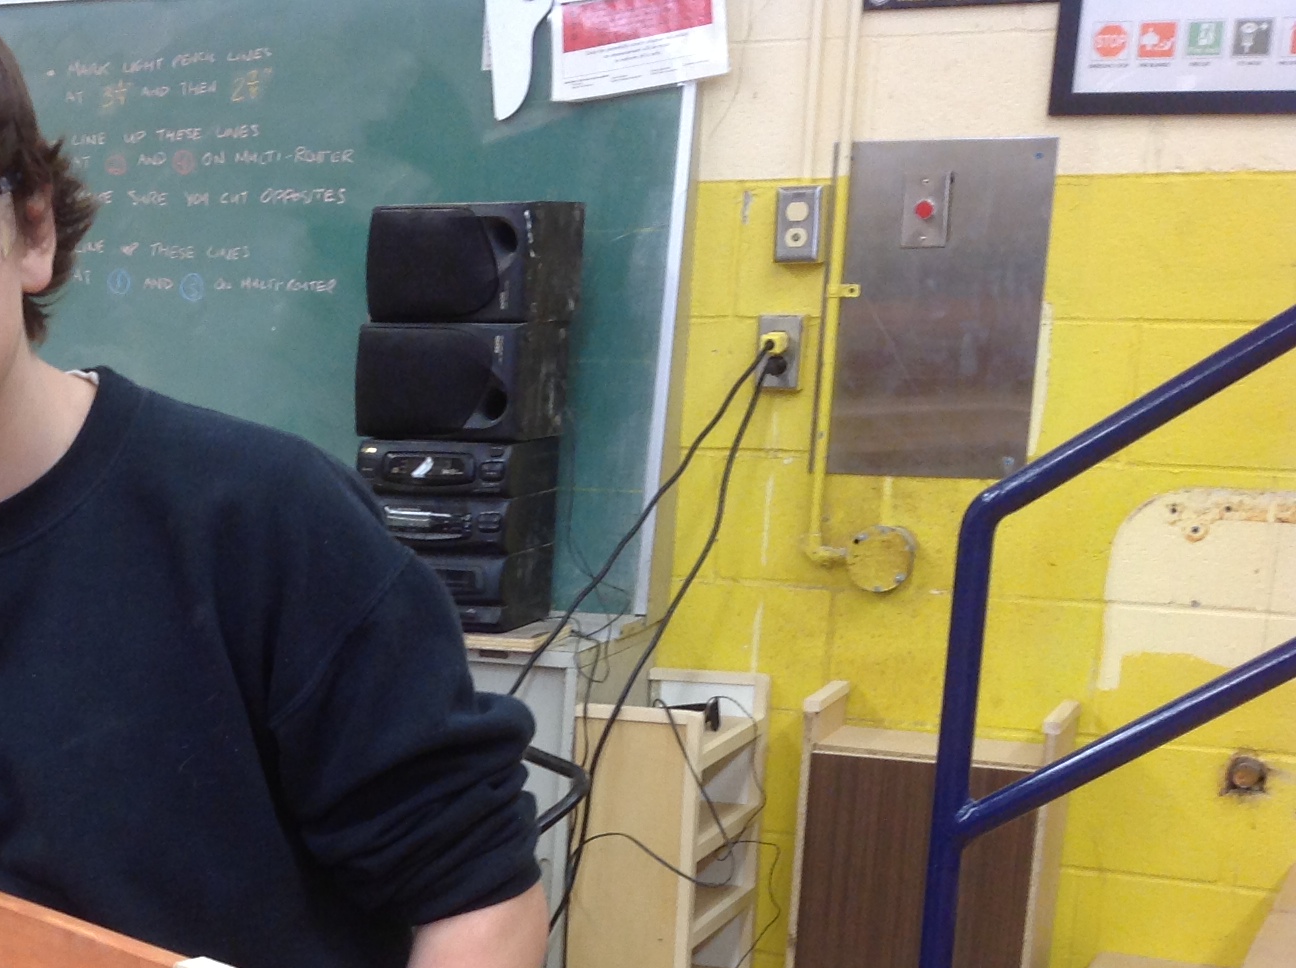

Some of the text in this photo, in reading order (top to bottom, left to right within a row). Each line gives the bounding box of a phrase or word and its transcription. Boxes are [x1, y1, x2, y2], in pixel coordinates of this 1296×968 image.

[68, 59, 110, 76] MARK
[122, 58, 164, 73] LIGHT
[227, 47, 272, 62] LINES
[65, 90, 84, 104] AT
[141, 86, 170, 98] AND
[180, 80, 217, 96] THEN
[71, 123, 260, 146] LINE UP THESE LINES
[138, 151, 167, 166] AND
[202, 151, 226, 166] ON
[127, 189, 169, 206] SURE
[185, 190, 210, 207] YOU
[220, 190, 249, 205] CUT
[260, 187, 347, 205] OPPOSITES
[150, 241, 195, 260] THESE
[207, 245, 251, 260] LINES
[73, 269, 91, 285] AT
[143, 278, 174, 290] AND
